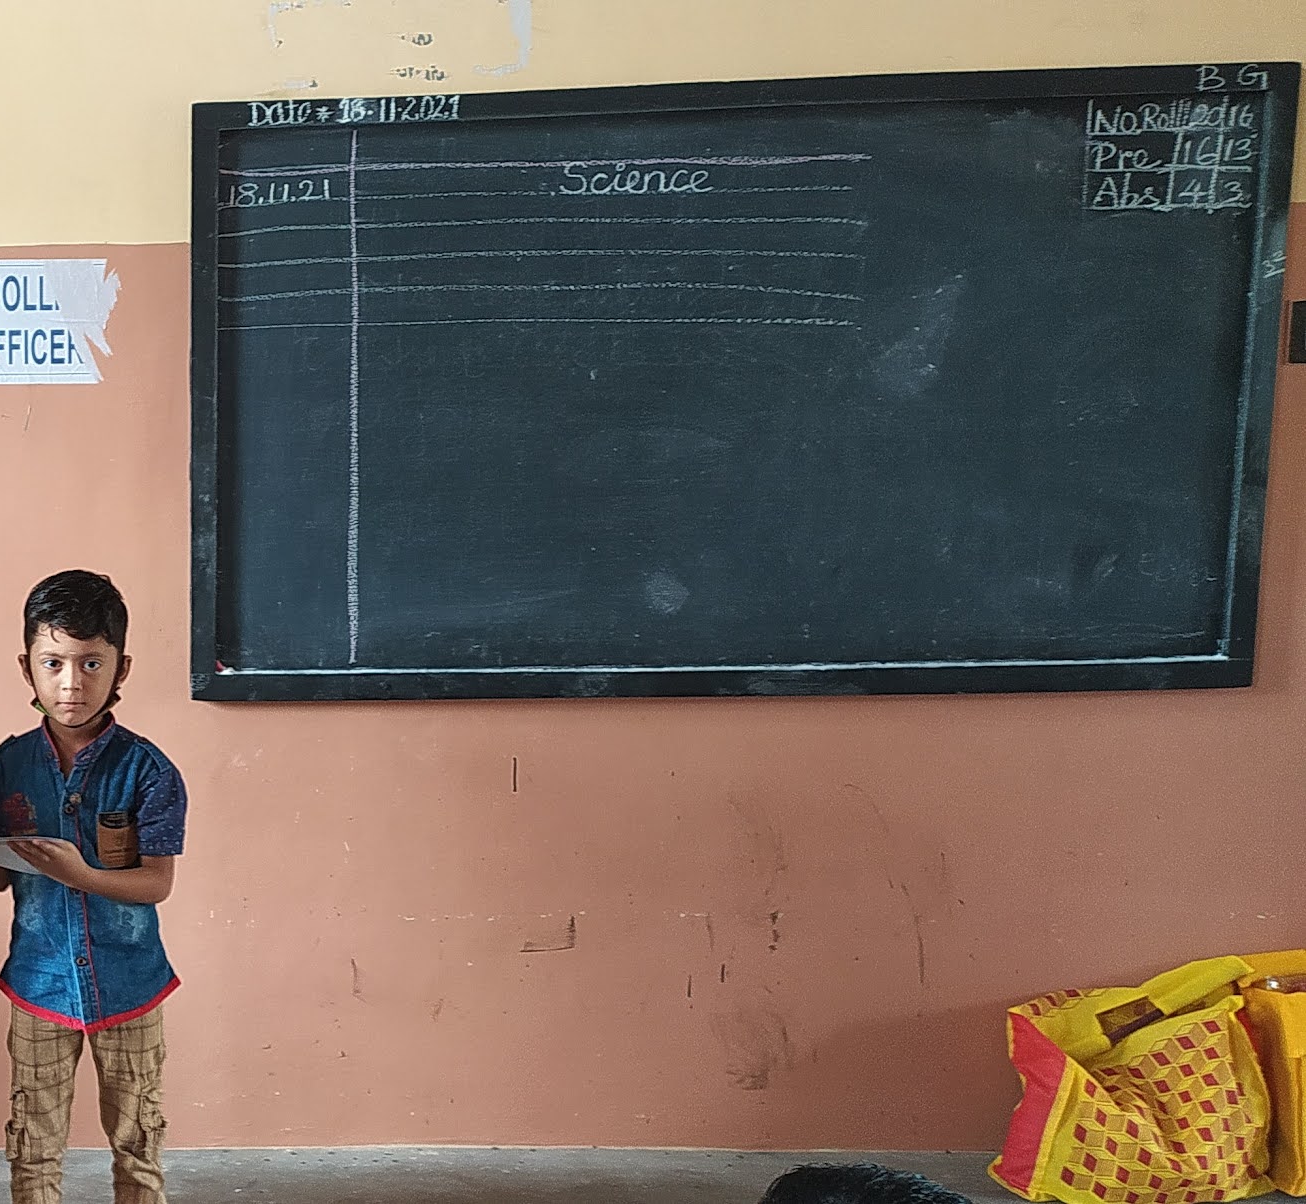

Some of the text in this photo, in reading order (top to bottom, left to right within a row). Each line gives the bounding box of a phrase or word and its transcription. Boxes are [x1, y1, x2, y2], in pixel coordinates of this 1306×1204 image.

[1196, 65, 1226, 92] B
[559, 161, 715, 194] Science
[1094, 172, 1161, 209] Abs
